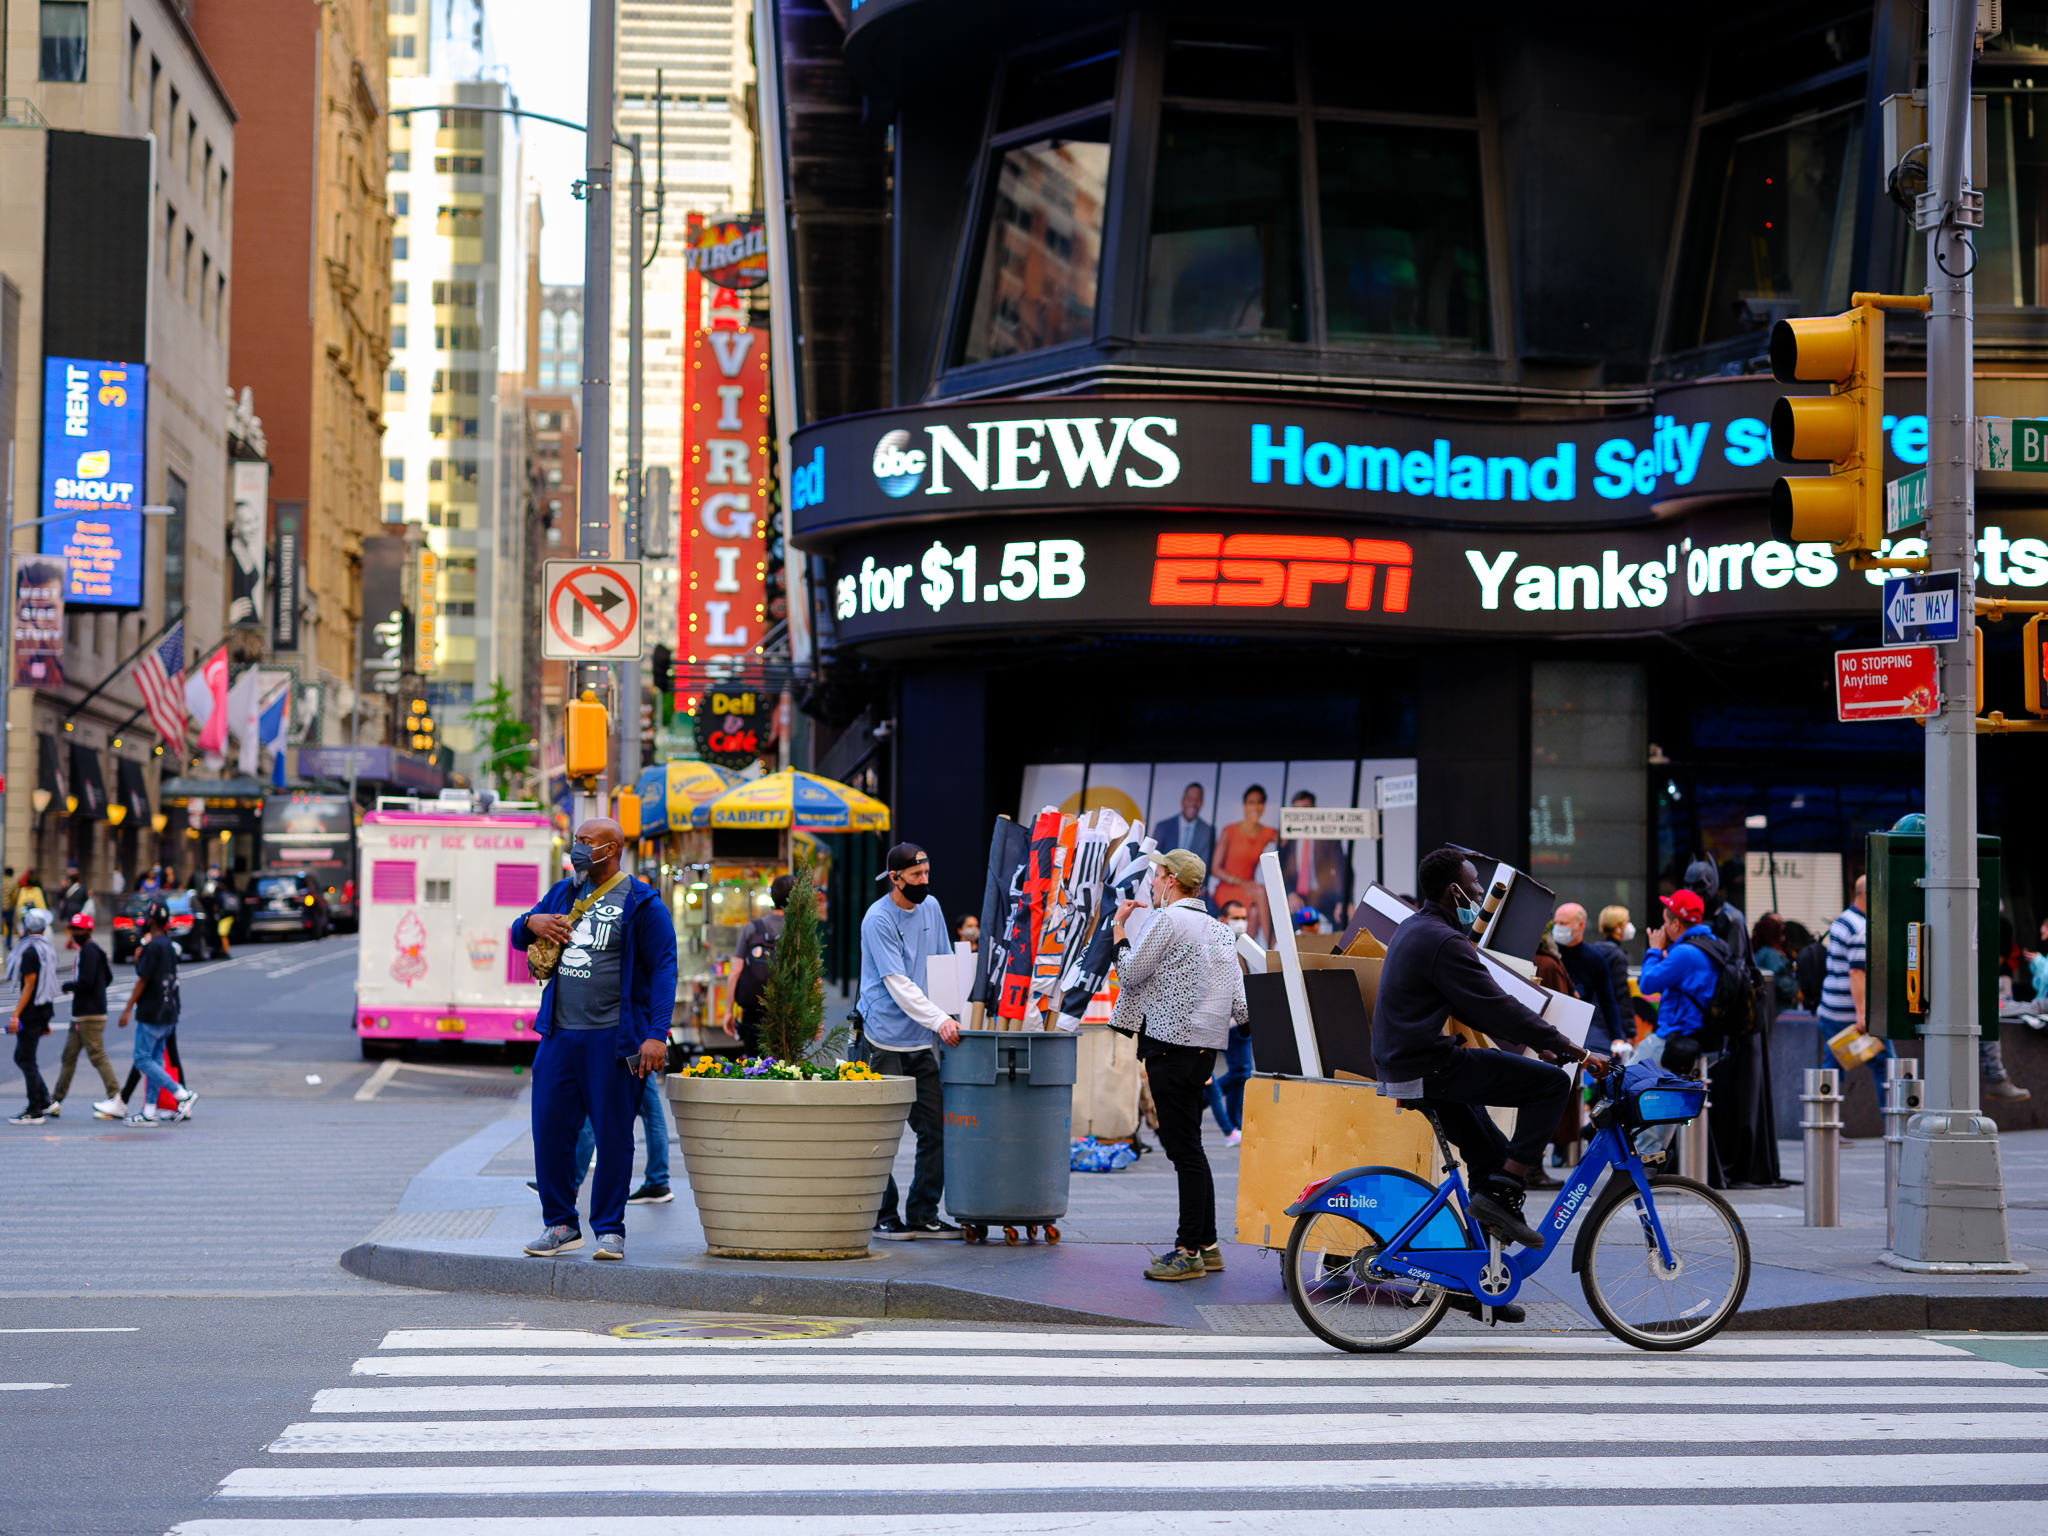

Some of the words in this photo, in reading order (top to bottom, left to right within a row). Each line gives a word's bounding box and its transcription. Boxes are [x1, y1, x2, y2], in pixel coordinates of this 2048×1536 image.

[65, 364, 89, 437] RENT
[872, 444, 927, 478] abc
[924, 416, 1181, 495] NEWS
[1250, 423, 1576, 502] Homeland
[54, 478, 134, 502] SHOUT
[1899, 483, 1910, 522] W
[859, 555, 914, 614] for
[920, 539, 1086, 613] $1.5B
[1149, 531, 1414, 614] ESPN
[1465, 543, 1677, 611] Yanks'
[1680, 536, 1839, 597] orres
[1894, 598, 1915, 624] ONE
[1925, 593, 1949, 621] WAY
[1841, 658, 1857, 672] NO
[1861, 654, 1913, 671] STOPPING
[1843, 672, 1889, 690] Anytime
[712, 692, 756, 715] Deli
[714, 809, 787, 824] SABRETT
[388, 834, 430, 849] SOFT
[441, 835, 465, 850] ICE
[473, 836, 525, 850] CREAM
[1349, 1195, 1378, 1209] bike
[1562, 1183, 1588, 1211] bike
[1407, 1267, 1432, 1281] 42549
